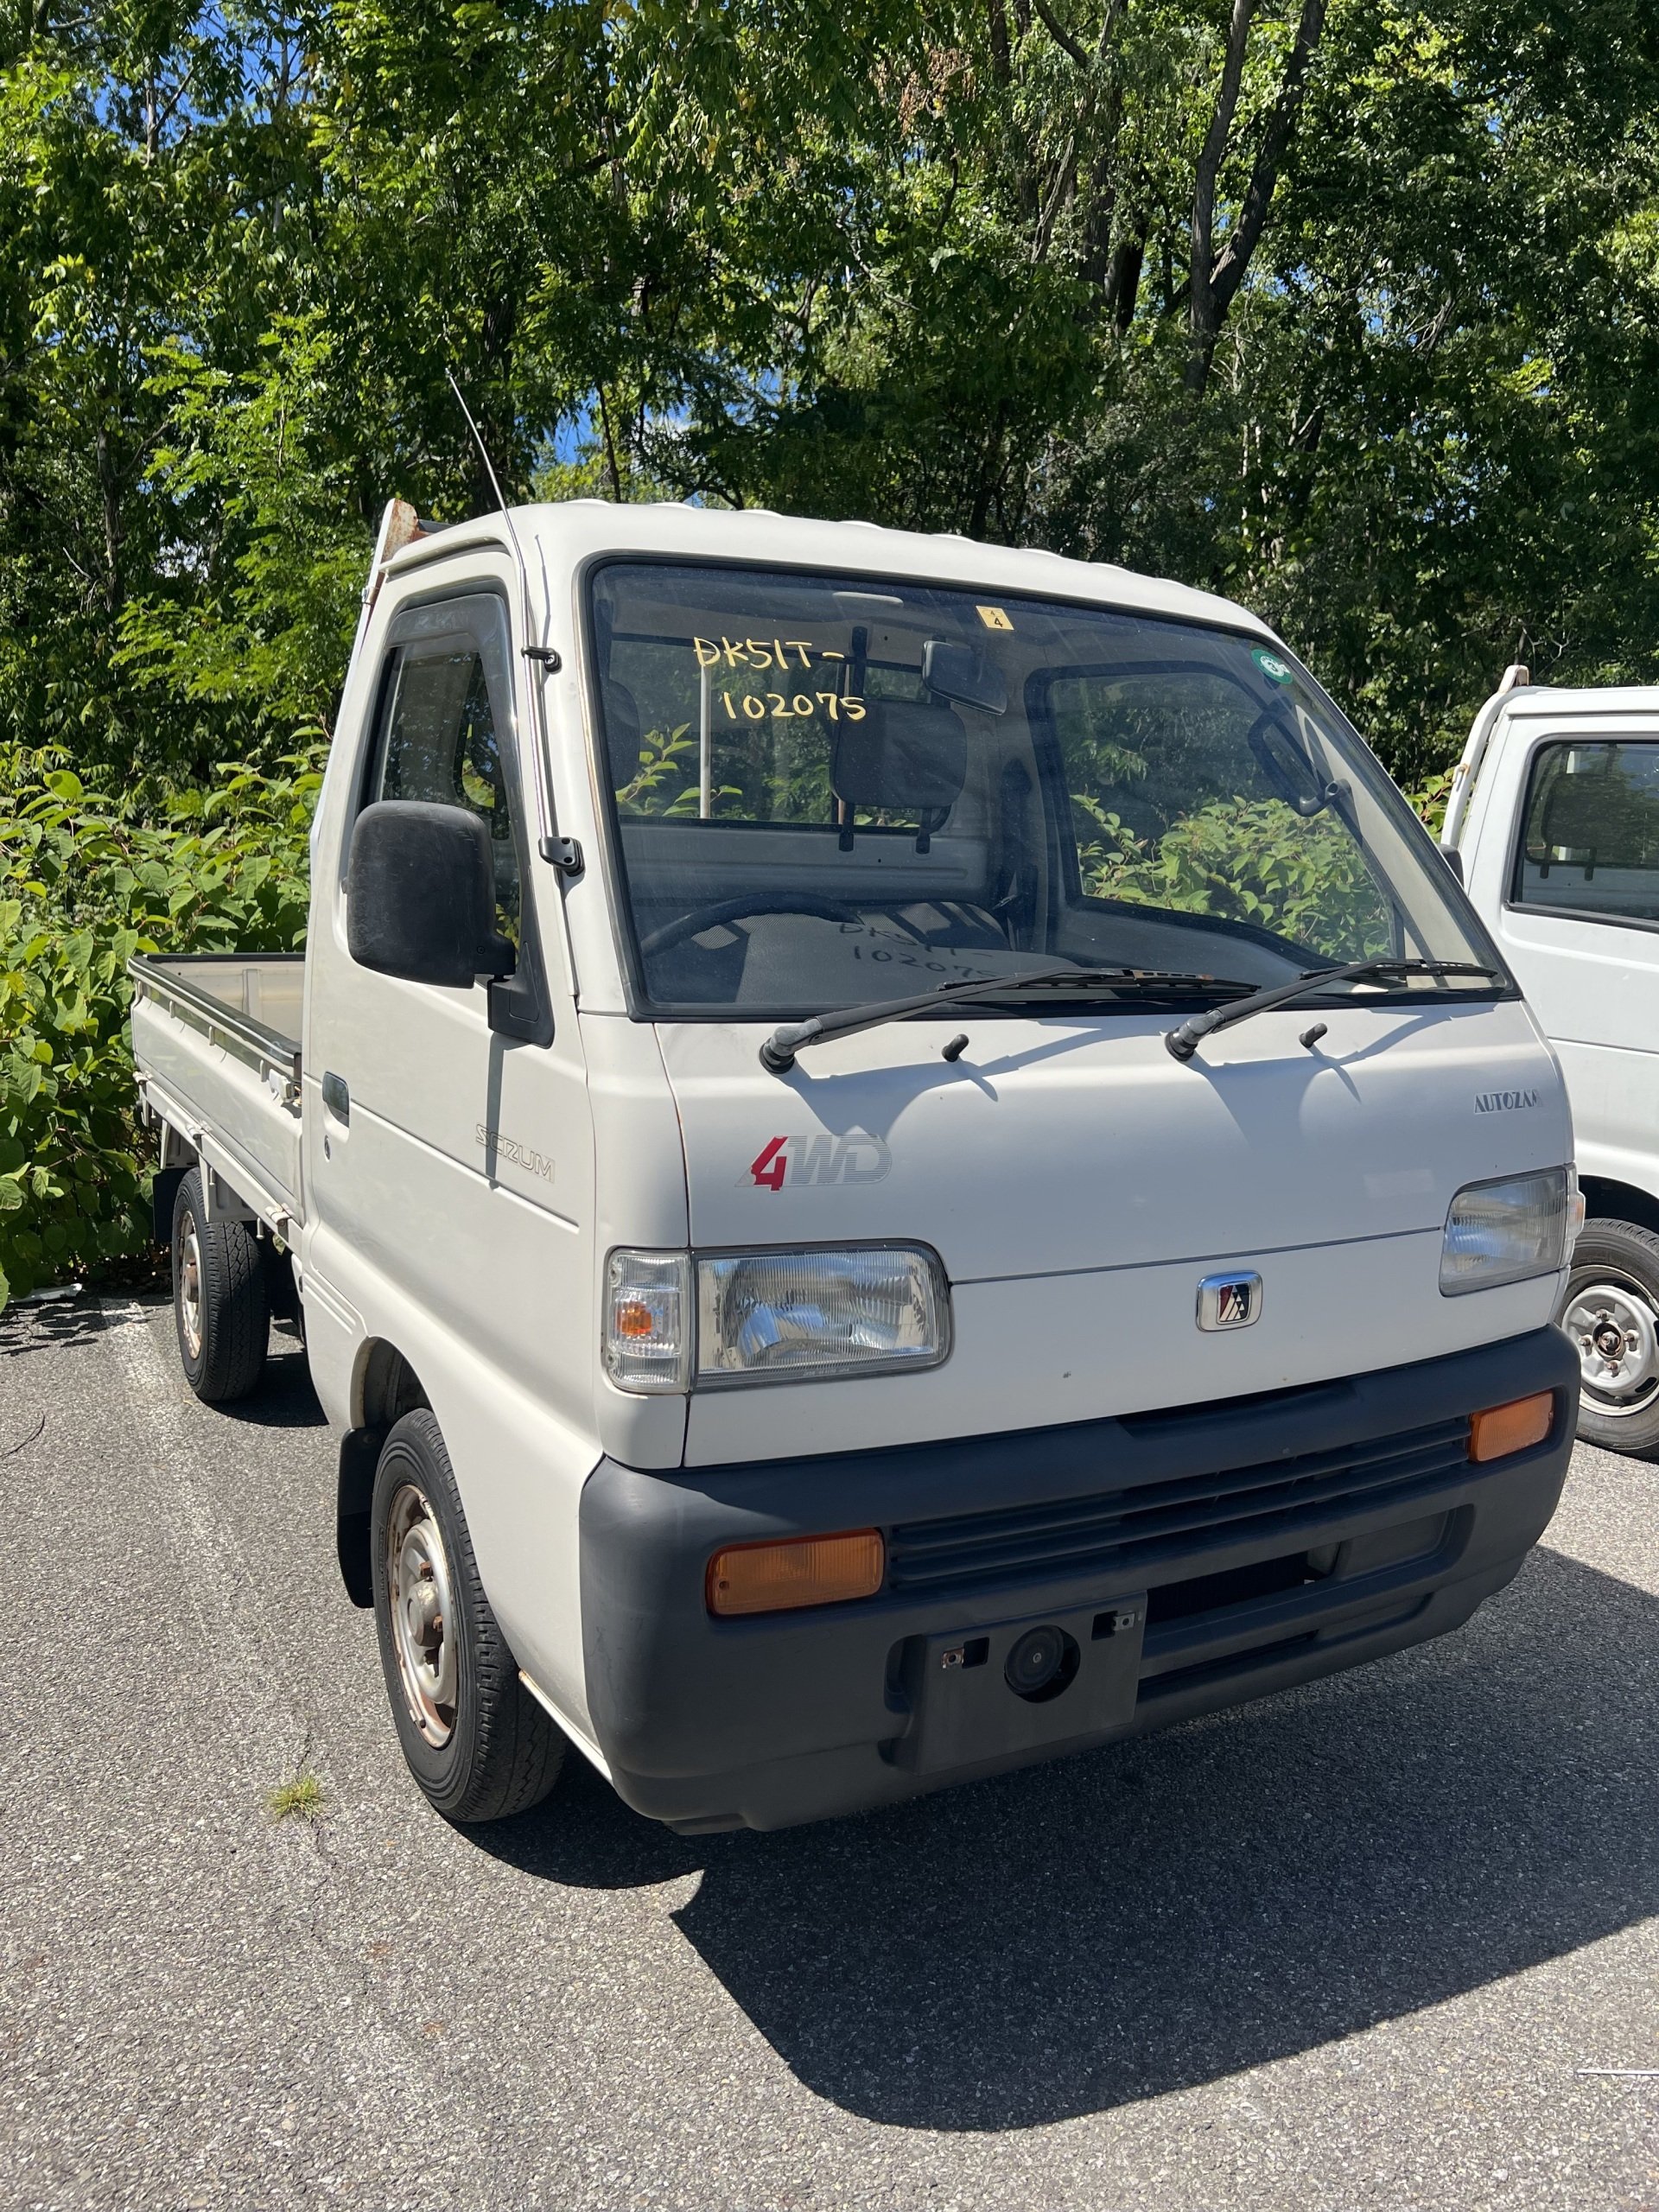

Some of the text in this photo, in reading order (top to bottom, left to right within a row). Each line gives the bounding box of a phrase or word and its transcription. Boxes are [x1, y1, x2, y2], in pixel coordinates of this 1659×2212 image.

[994, 617, 1003, 627] 4
[723, 691, 867, 720] 102075
[475, 1123, 555, 1183] SCRUM
[750, 1135, 893, 1192] 4WD
